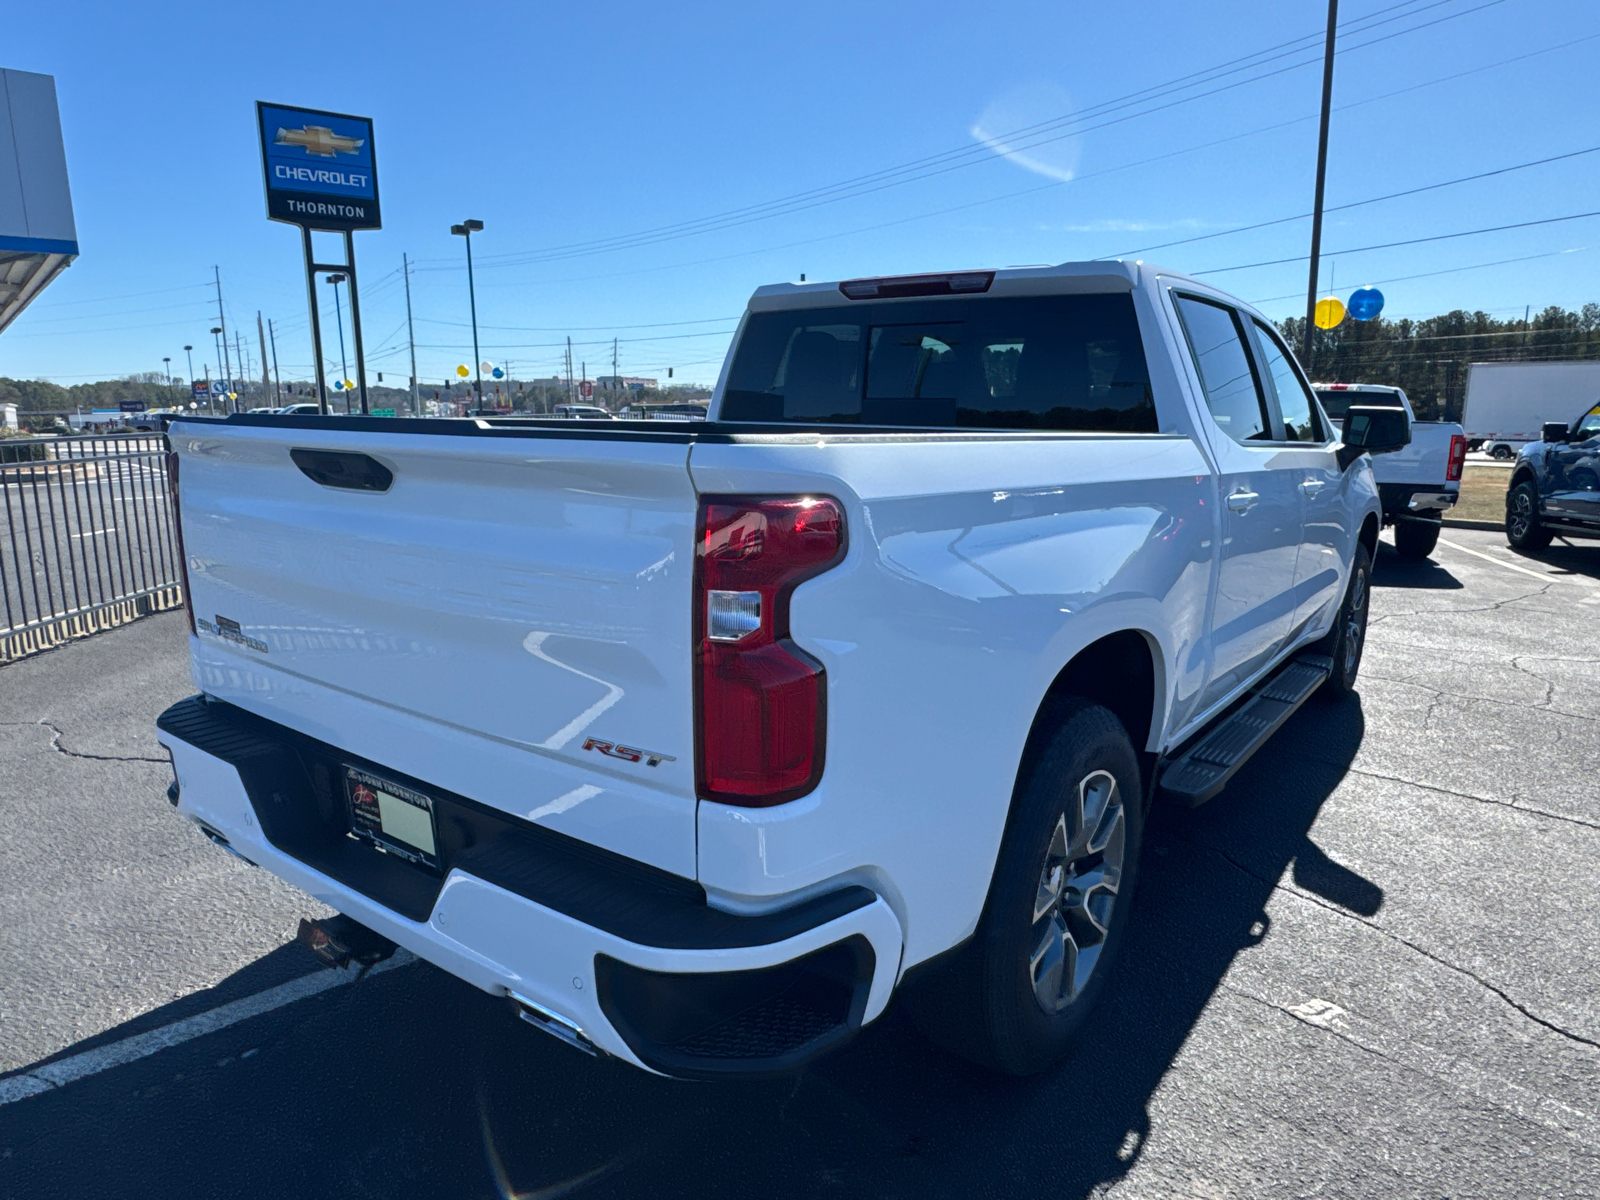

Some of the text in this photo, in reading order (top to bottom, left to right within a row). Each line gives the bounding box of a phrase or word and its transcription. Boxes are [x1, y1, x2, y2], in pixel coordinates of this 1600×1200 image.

[275, 165, 368, 187] CHEVROLET
[287, 200, 365, 218] THORNTON
[582, 736, 677, 767] RST
